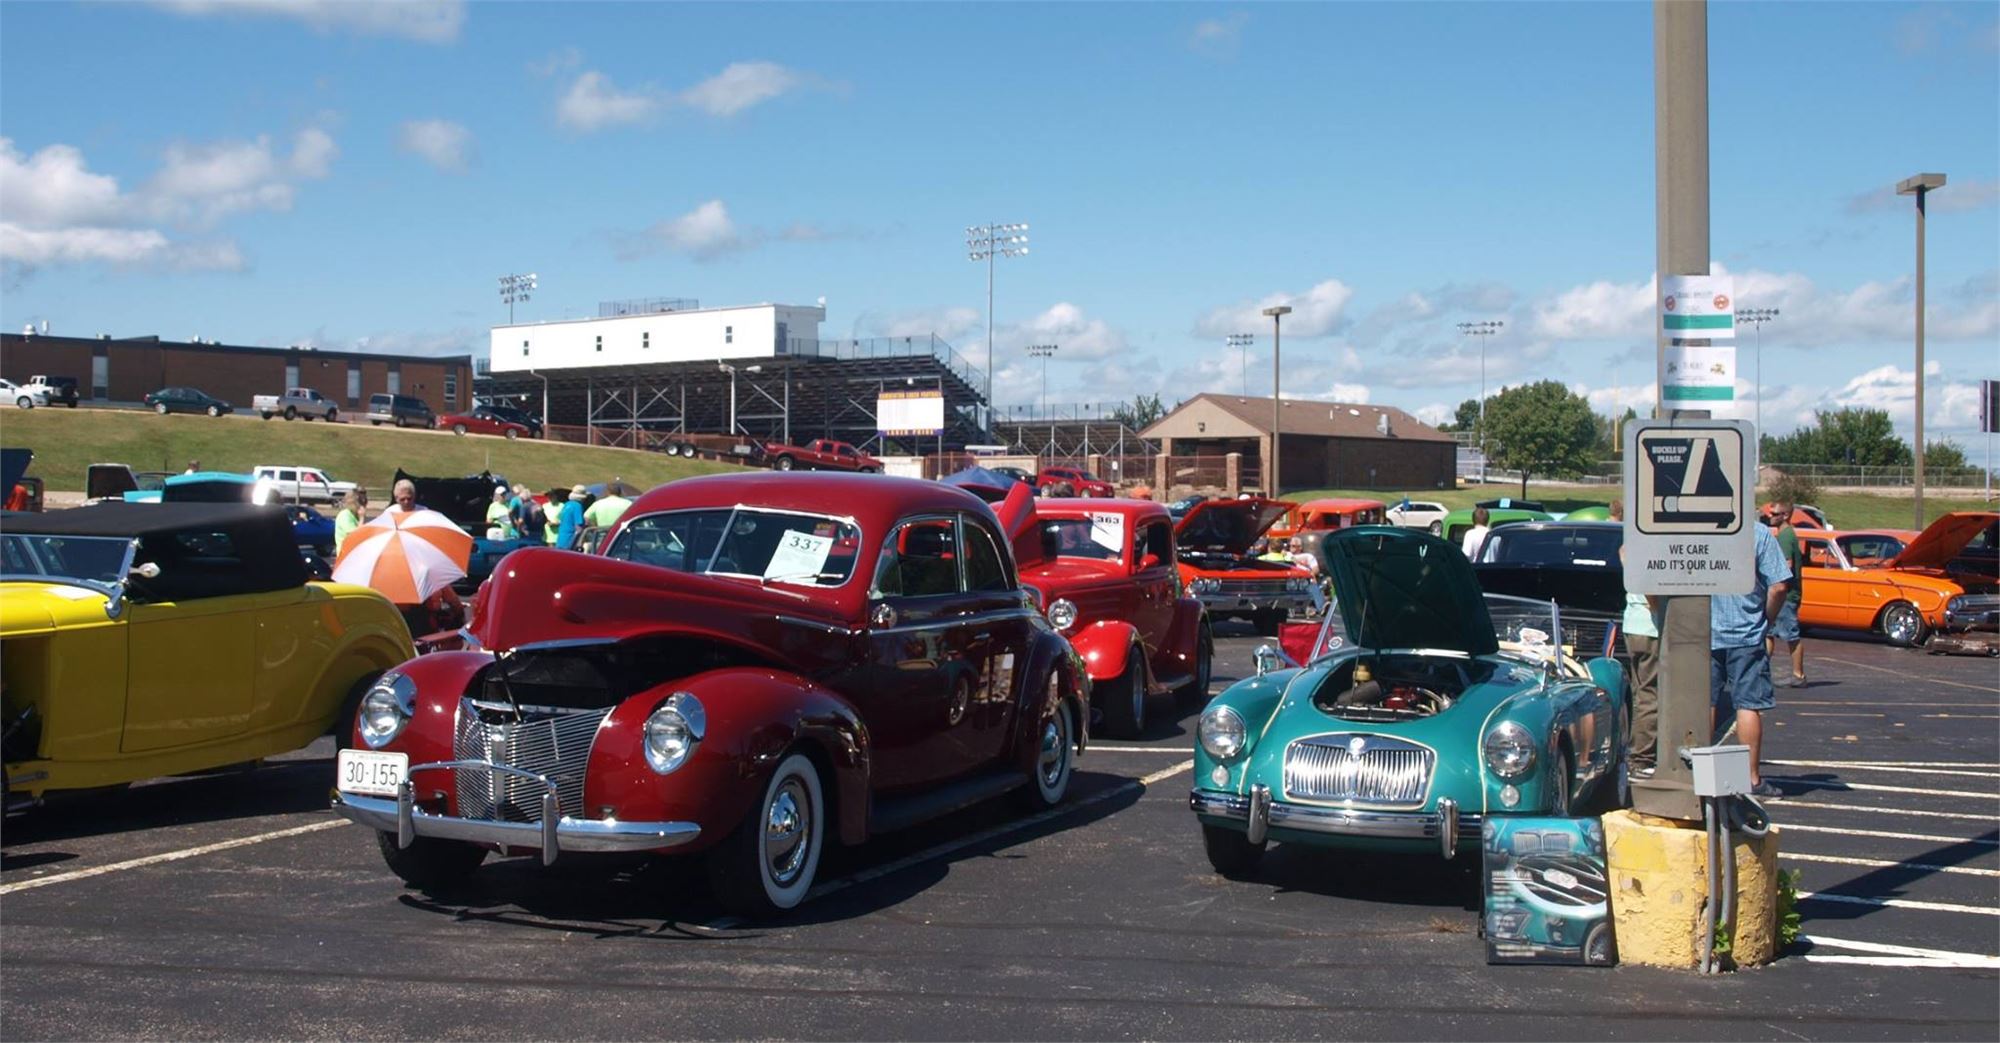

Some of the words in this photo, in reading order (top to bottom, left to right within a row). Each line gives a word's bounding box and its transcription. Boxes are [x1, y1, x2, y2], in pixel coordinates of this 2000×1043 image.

[1651, 446, 1677, 454] BUCKLE
[1677, 446, 1687, 454] UP
[1657, 455, 1684, 463] PLEASE.
[1097, 515, 1119, 524] 363
[789, 536, 822, 552] 337
[1669, 544, 1684, 555] WE
[1686, 544, 1709, 555] CARE
[1647, 560, 1667, 570] AND
[1669, 560, 1685, 570] IT'S
[1686, 560, 1707, 570] OUR
[1709, 560, 1731, 571] LAW.
